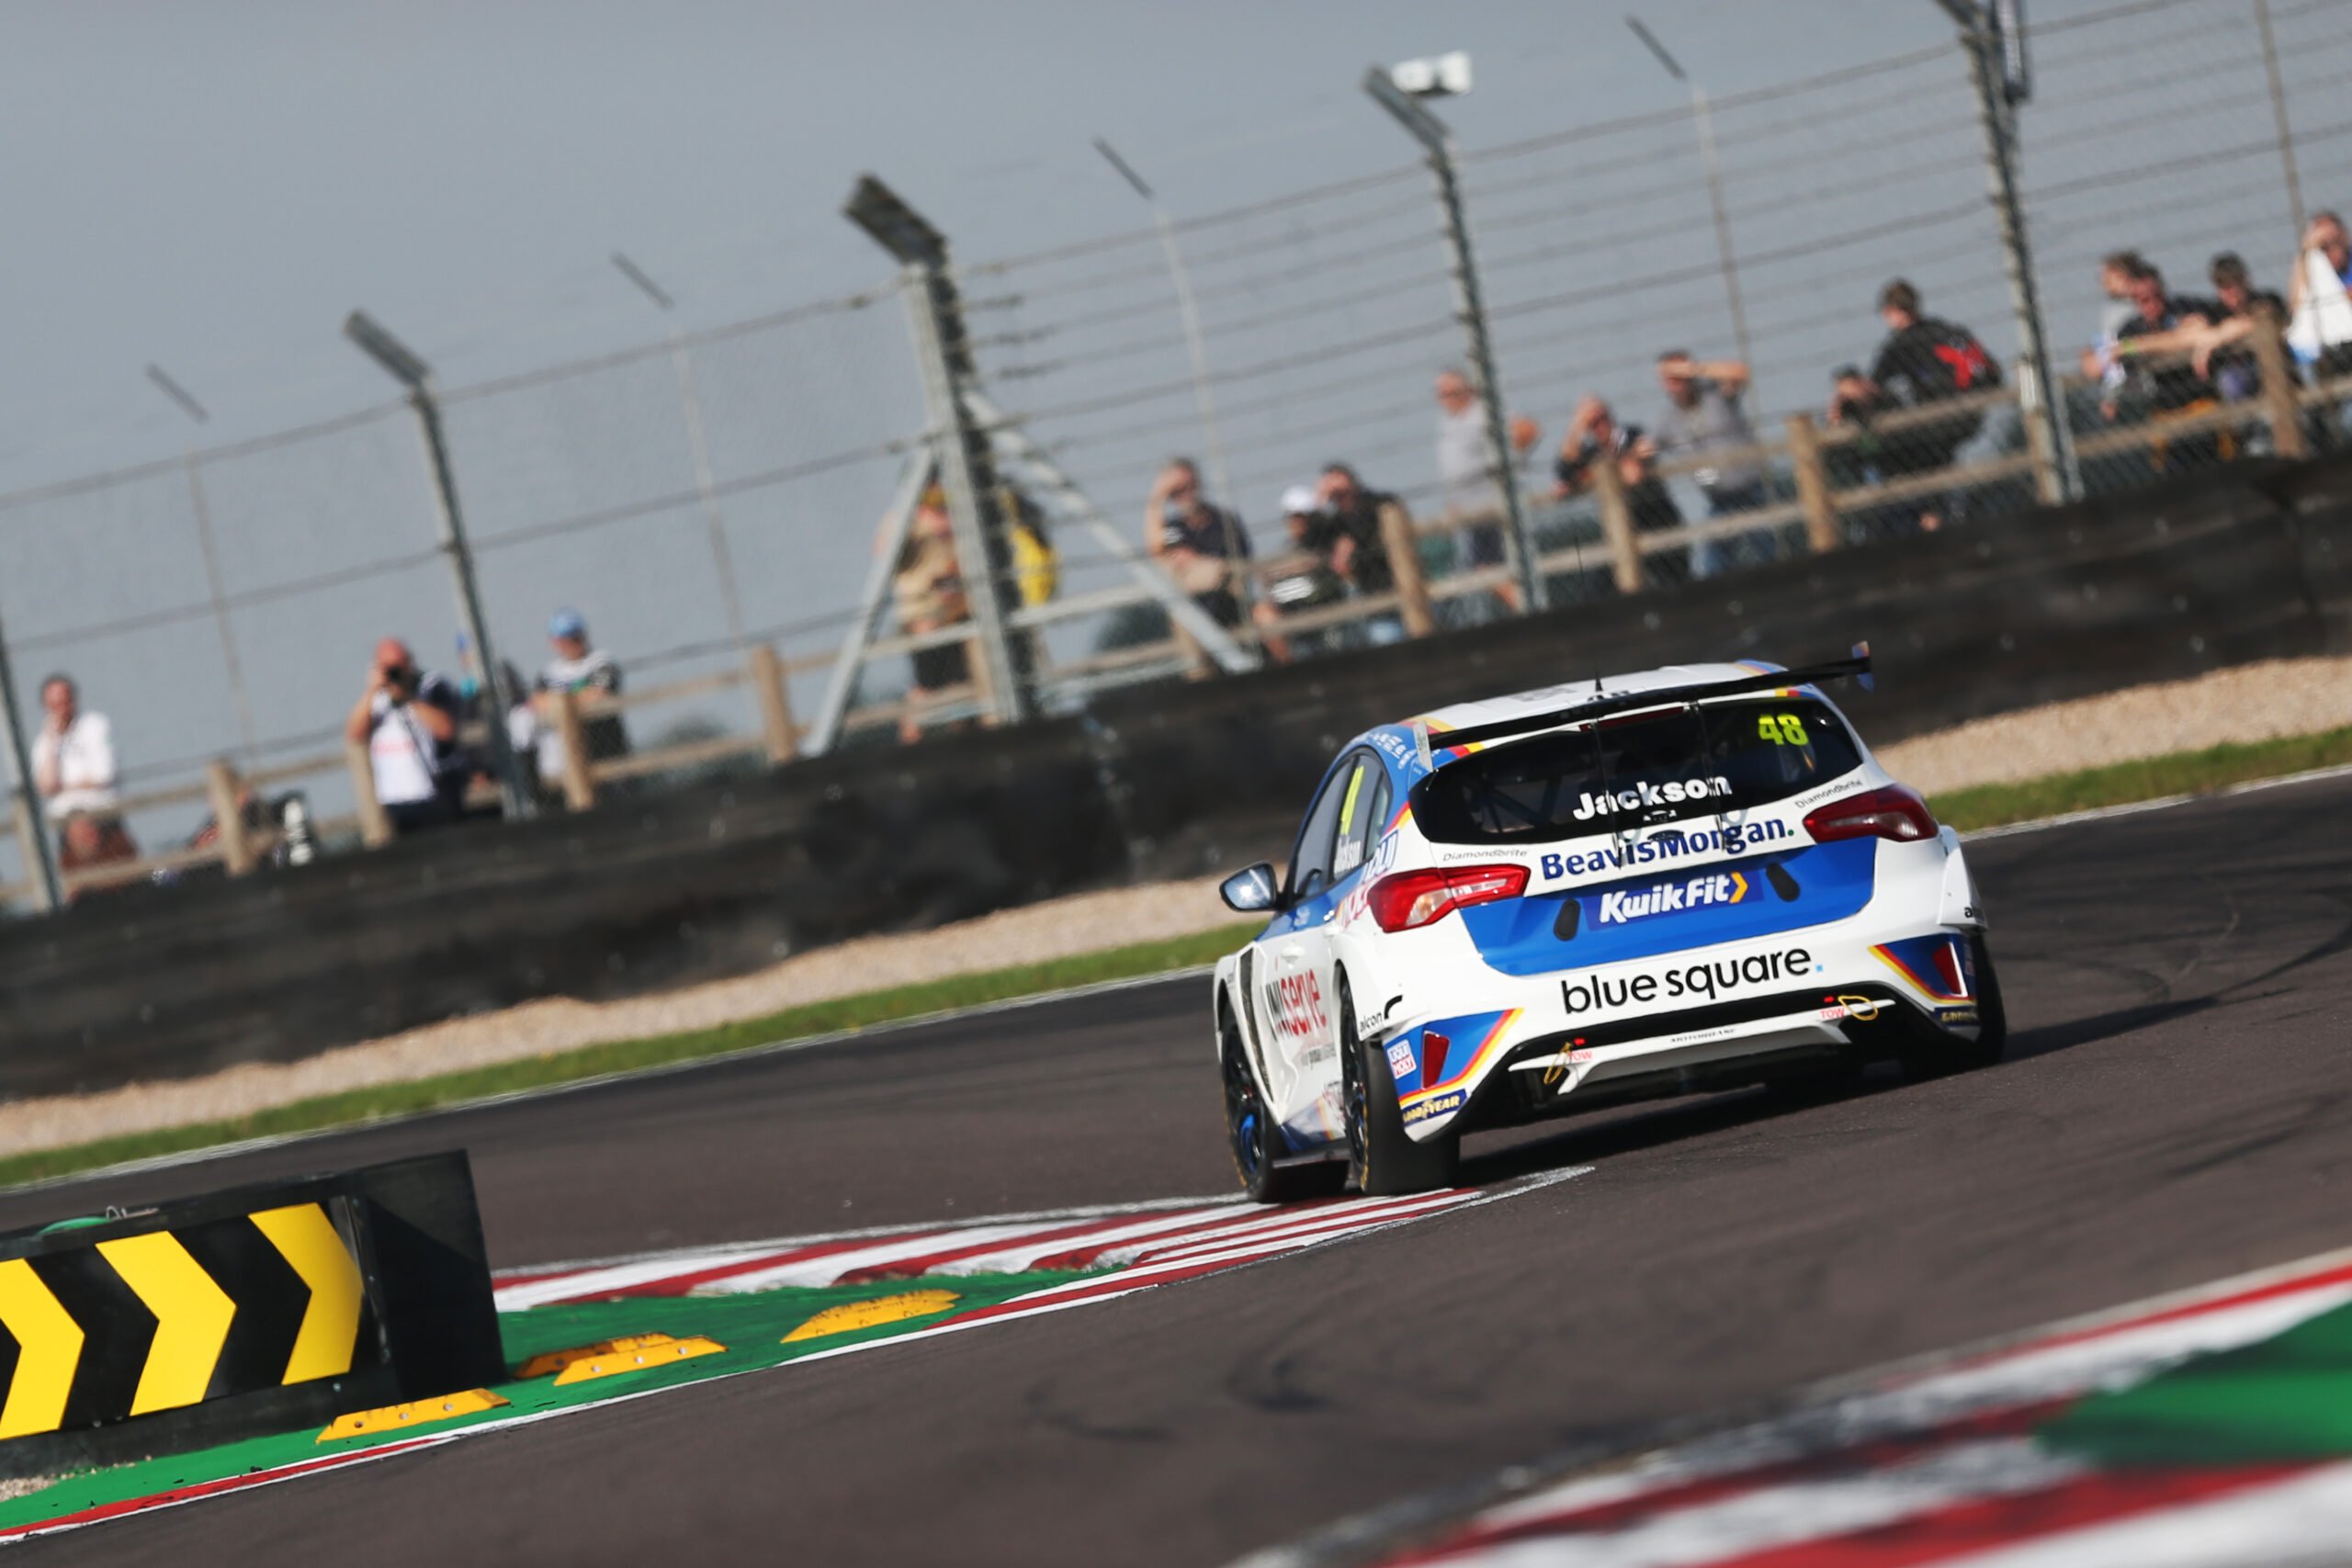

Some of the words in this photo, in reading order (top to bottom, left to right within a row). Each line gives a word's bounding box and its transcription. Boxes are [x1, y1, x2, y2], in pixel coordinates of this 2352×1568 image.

[1758, 714, 1809, 746] 48
[1572, 775, 1733, 820] Jackson
[1561, 973, 1658, 1014] blue
[1821, 1008, 1845, 1021] TOW
